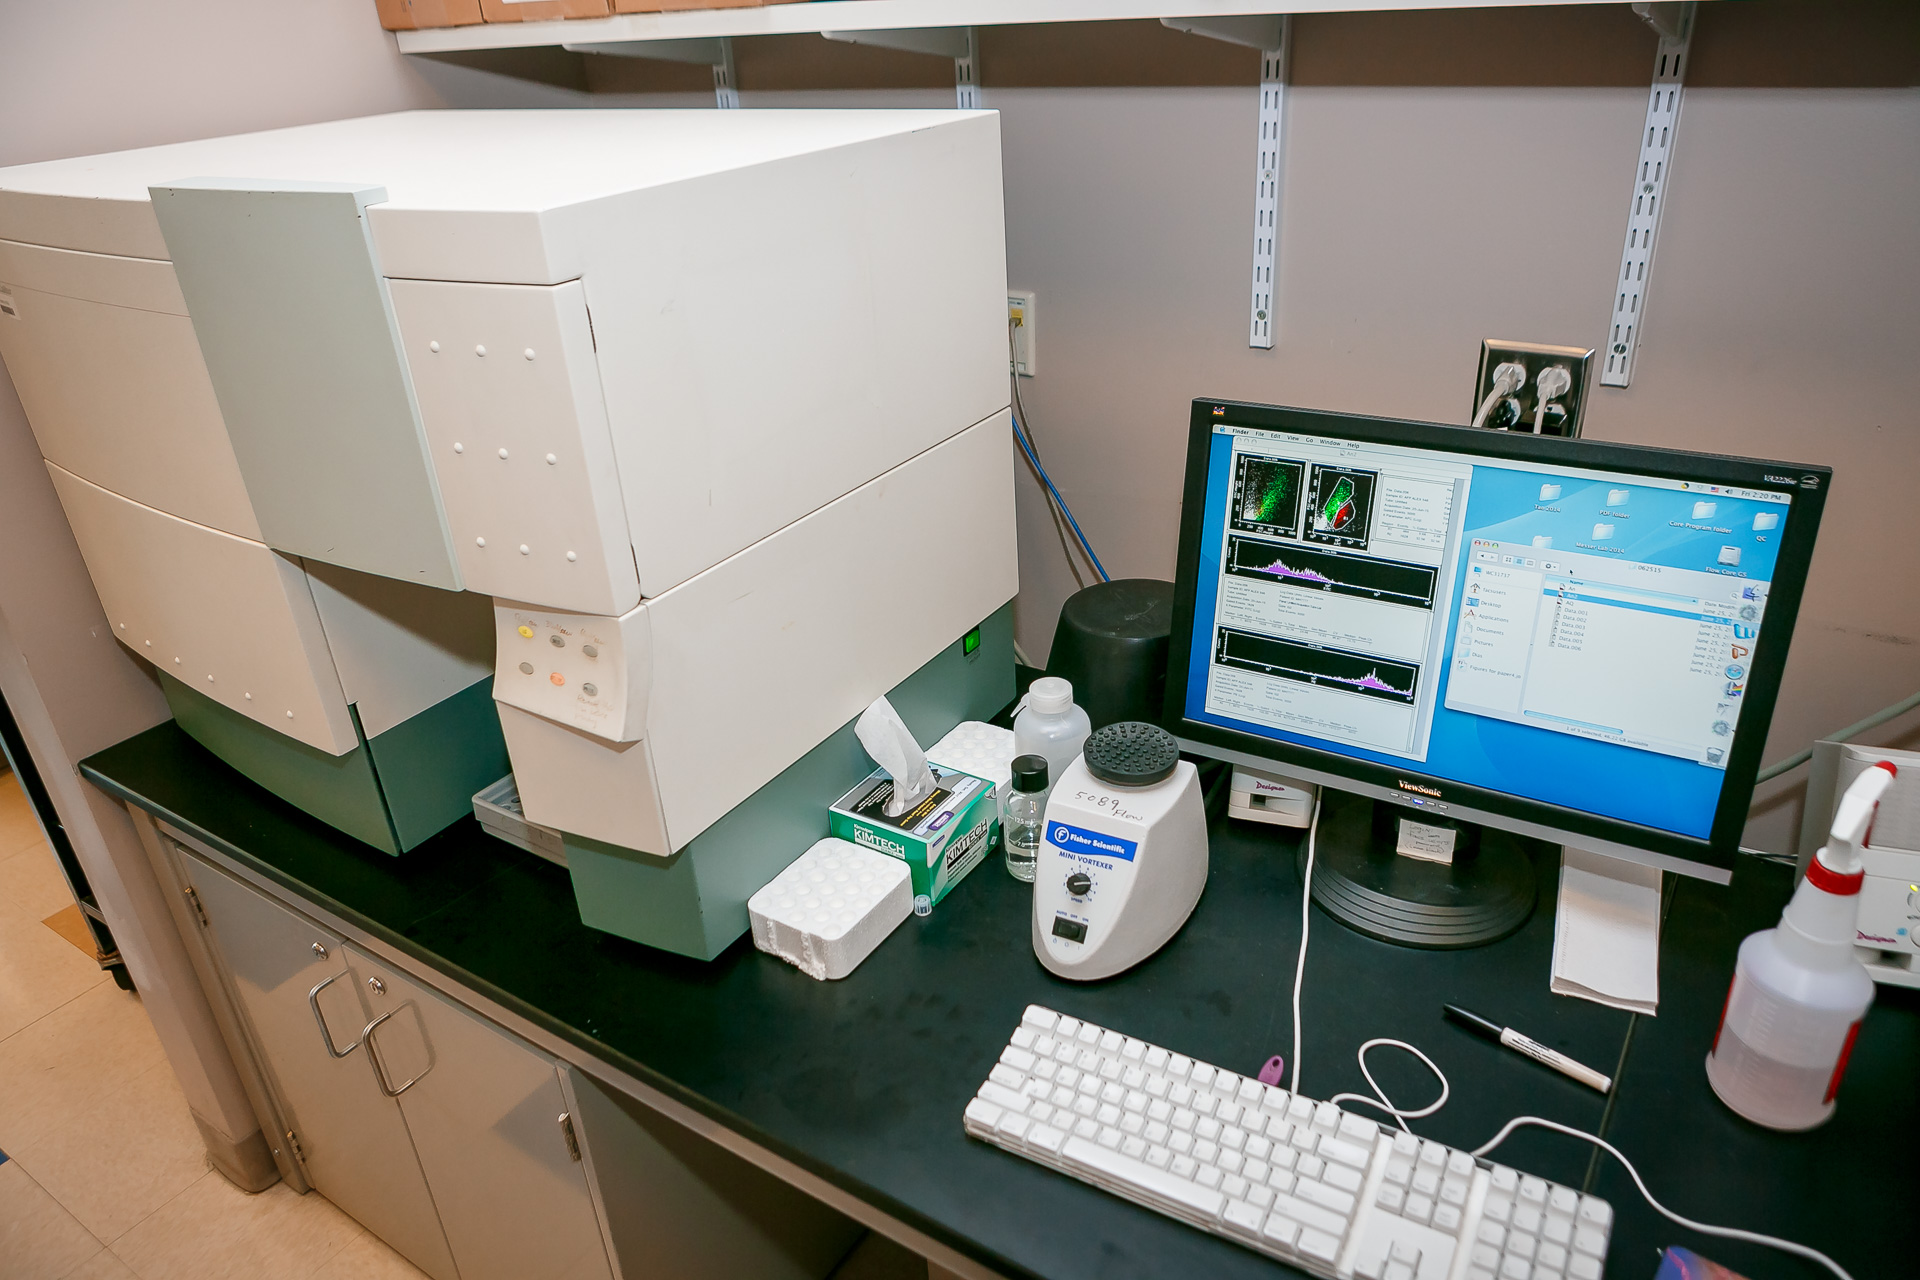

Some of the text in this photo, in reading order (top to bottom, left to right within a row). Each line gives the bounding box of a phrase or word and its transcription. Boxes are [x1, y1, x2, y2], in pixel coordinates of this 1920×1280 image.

[1753, 491, 1768, 499] 2:20
[1669, 520, 1732, 534] Core Program folder
[1638, 565, 1661, 573] 062515
[1481, 600, 1502, 609] Desktop
[1564, 607, 1588, 616] Data.001
[1478, 613, 1509, 623] Applications
[1561, 621, 1586, 630] Data.003
[1476, 626, 1504, 636] Documents
[1560, 629, 1584, 637] Data.004
[1474, 639, 1494, 647] Pictures
[1559, 636, 1583, 644] Data.005
[1557, 643, 1582, 651] Data.006
[1470, 665, 1488, 673] Figures
[1399, 779, 1442, 797] ViewSonic
[1074, 791, 1120, 811] 5089
[1112, 809, 1143, 821] Flow
[854, 829, 905, 855] KIMTECH
[946, 818, 987, 864] KIMTECH
[1070, 833, 1092, 846] Fisher
[1092, 839, 1125, 855] Scientific
[1059, 851, 1113, 871] MINI VORTEXER
